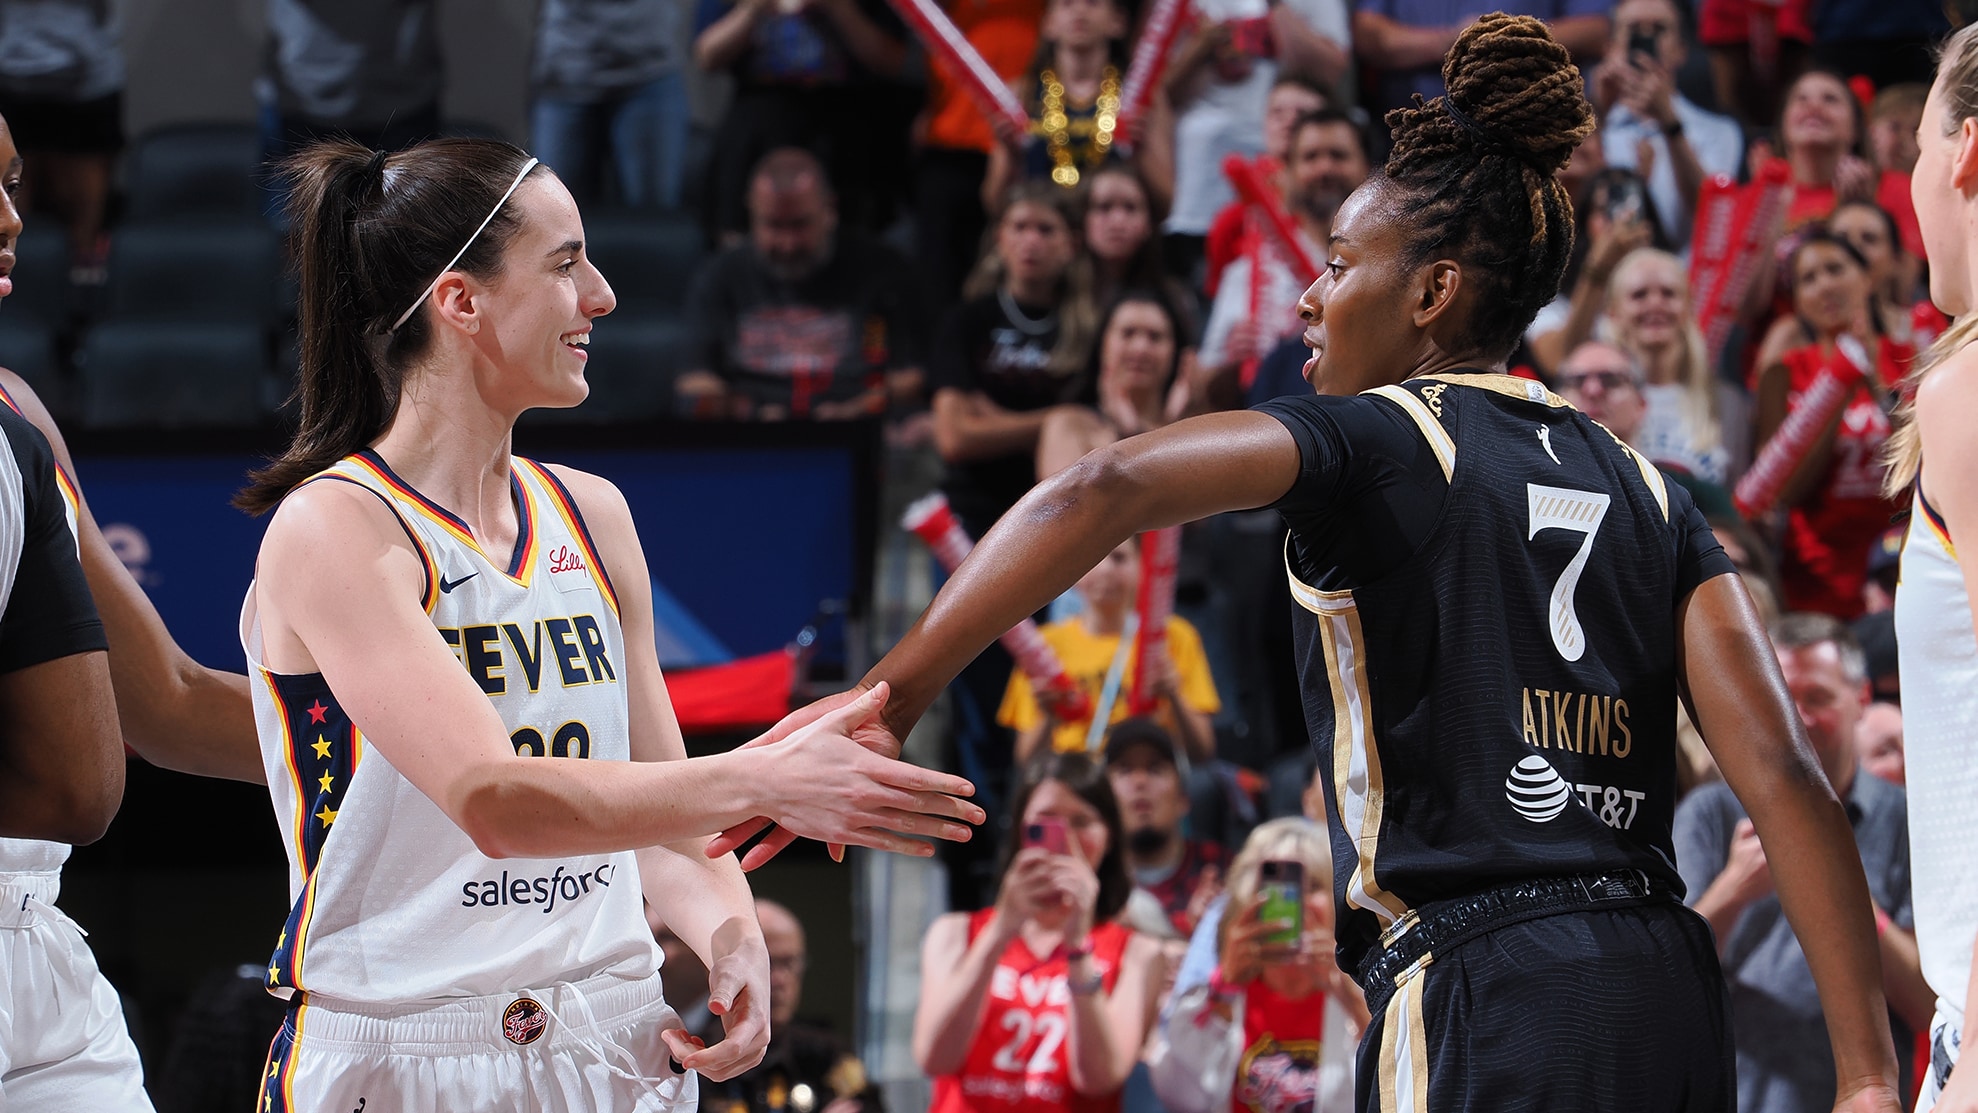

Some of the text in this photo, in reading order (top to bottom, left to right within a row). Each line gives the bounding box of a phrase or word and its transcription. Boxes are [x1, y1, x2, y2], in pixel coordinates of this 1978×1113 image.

[549, 545, 587, 578] Lilly
[1527, 482, 1611, 662] 7
[1522, 687, 1632, 759] ATKINS
[1566, 782, 1646, 830] T&T
[462, 864, 616, 914] salesforc
[992, 1008, 1066, 1074] 22
